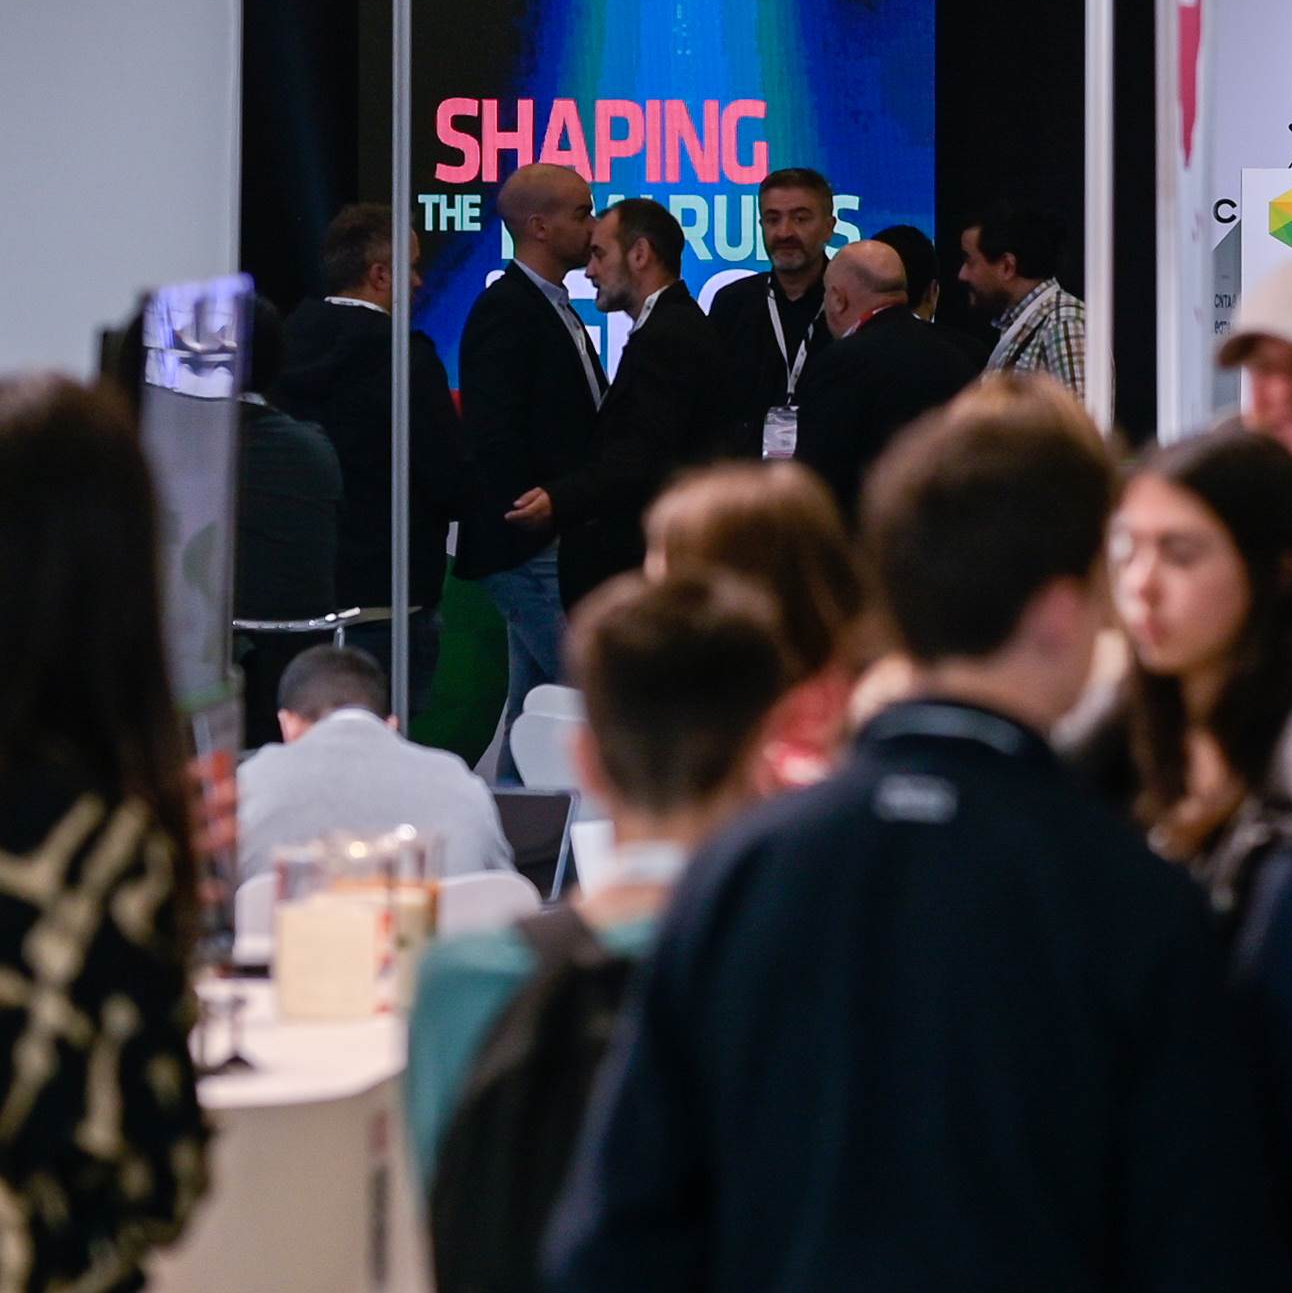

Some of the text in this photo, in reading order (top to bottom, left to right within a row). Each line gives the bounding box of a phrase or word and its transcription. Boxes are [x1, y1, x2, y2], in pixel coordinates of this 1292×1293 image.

[434, 96, 770, 185] SHAPING
[417, 193, 482, 232] THE
[668, 193, 861, 262] RUS
